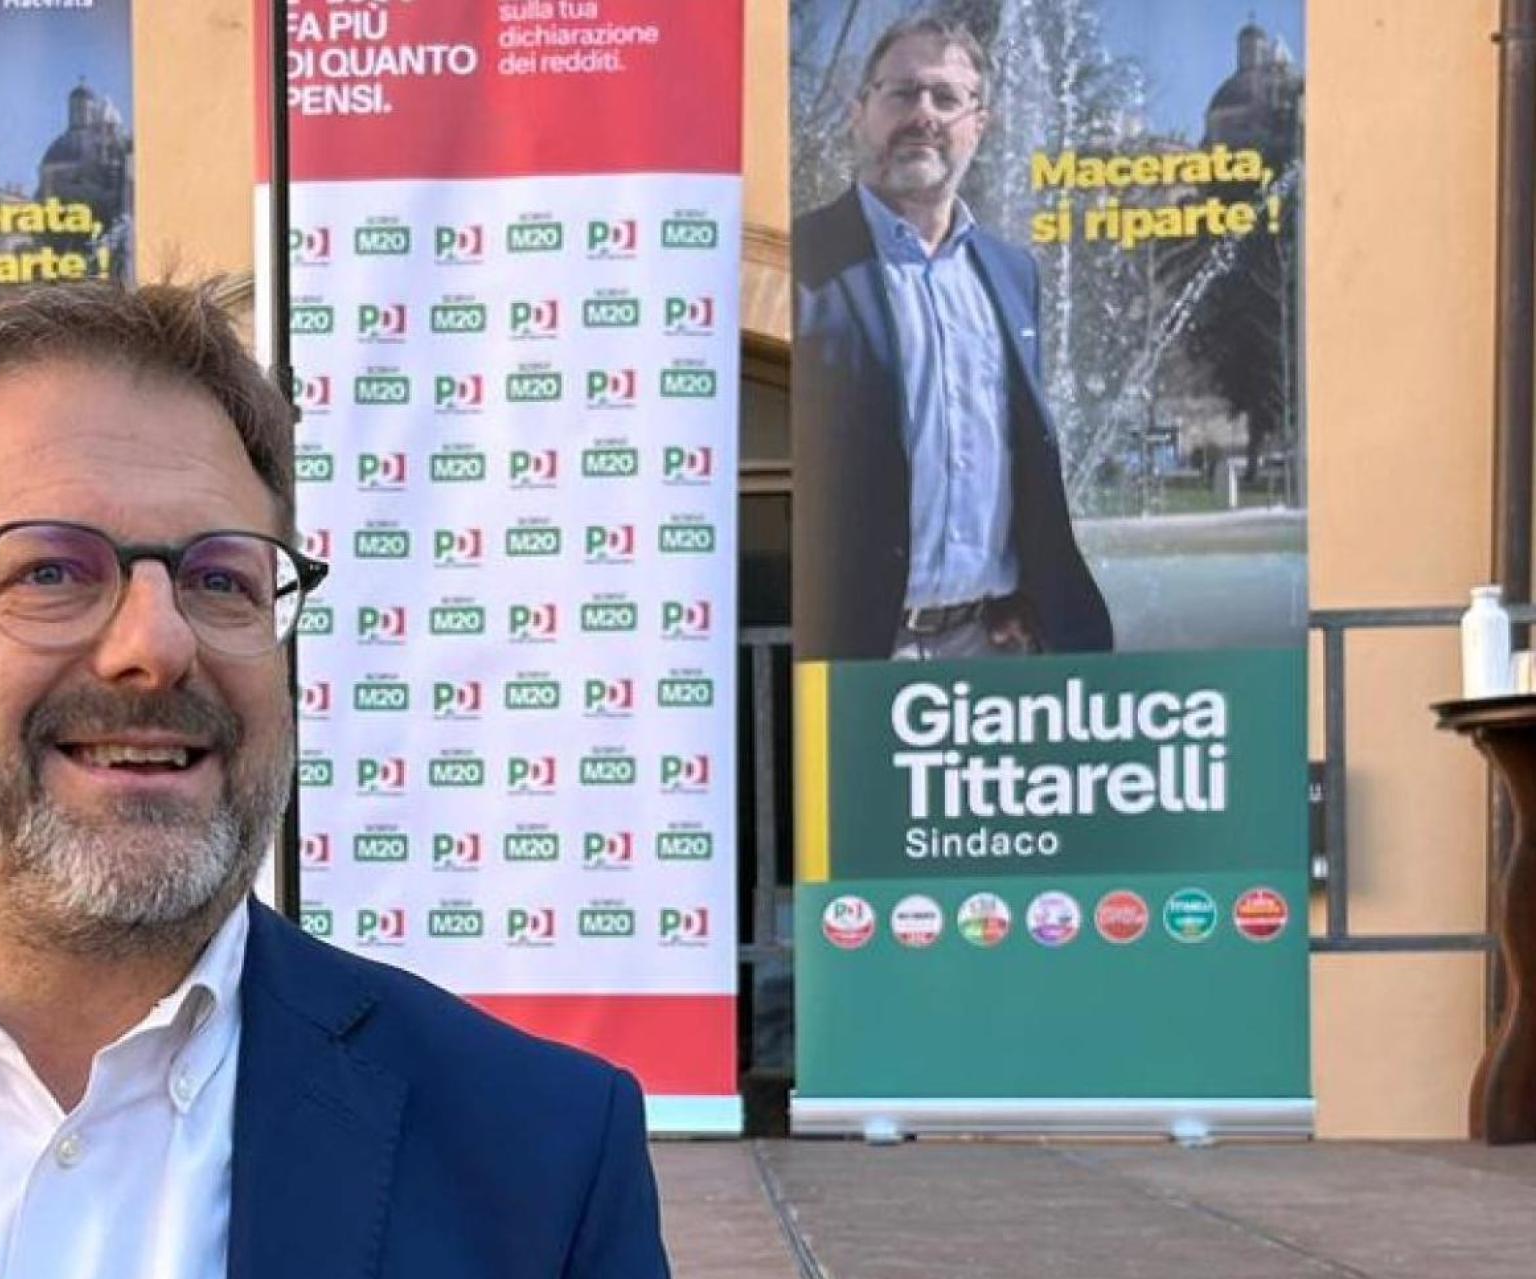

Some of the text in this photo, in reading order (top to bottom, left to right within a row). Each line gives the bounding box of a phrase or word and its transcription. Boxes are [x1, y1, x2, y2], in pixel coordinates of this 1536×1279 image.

[329, 2, 388, 40] PIÙ
[498, 21, 660, 47] dichiarazione
[319, 43, 479, 78] QUANTO
[497, 50, 537, 75] dei
[1030, 144, 1274, 193] Macerata,
[665, 223, 714, 245] M20
[1031, 197, 1282, 253] si riparte !
[359, 230, 406, 252] M20
[511, 226, 558, 249] M20
[98, 248, 111, 280] !
[434, 307, 481, 329] M20
[587, 302, 634, 324] M20
[358, 379, 405, 402] M20
[509, 377, 557, 399] M20
[664, 372, 712, 394] M20
[434, 457, 481, 478] M20
[586, 451, 633, 474] M20
[358, 533, 405, 555] M20
[509, 529, 556, 552] M20
[662, 527, 711, 549] M20
[433, 609, 480, 631] M20
[585, 606, 632, 628] M20
[357, 687, 405, 708] M20
[509, 684, 556, 705] M20
[661, 682, 710, 704] M20
[890, 677, 1230, 748] Gianluca
[432, 761, 479, 783] M20
[583, 760, 631, 782] M20
[892, 744, 1230, 821] Tittarelli
[357, 837, 404, 859] M20
[508, 836, 554, 858] M20
[661, 835, 708, 857] M20
[904, 827, 1060, 860] Sindaco
[432, 913, 478, 934] M20
[583, 913, 629, 934] M20
